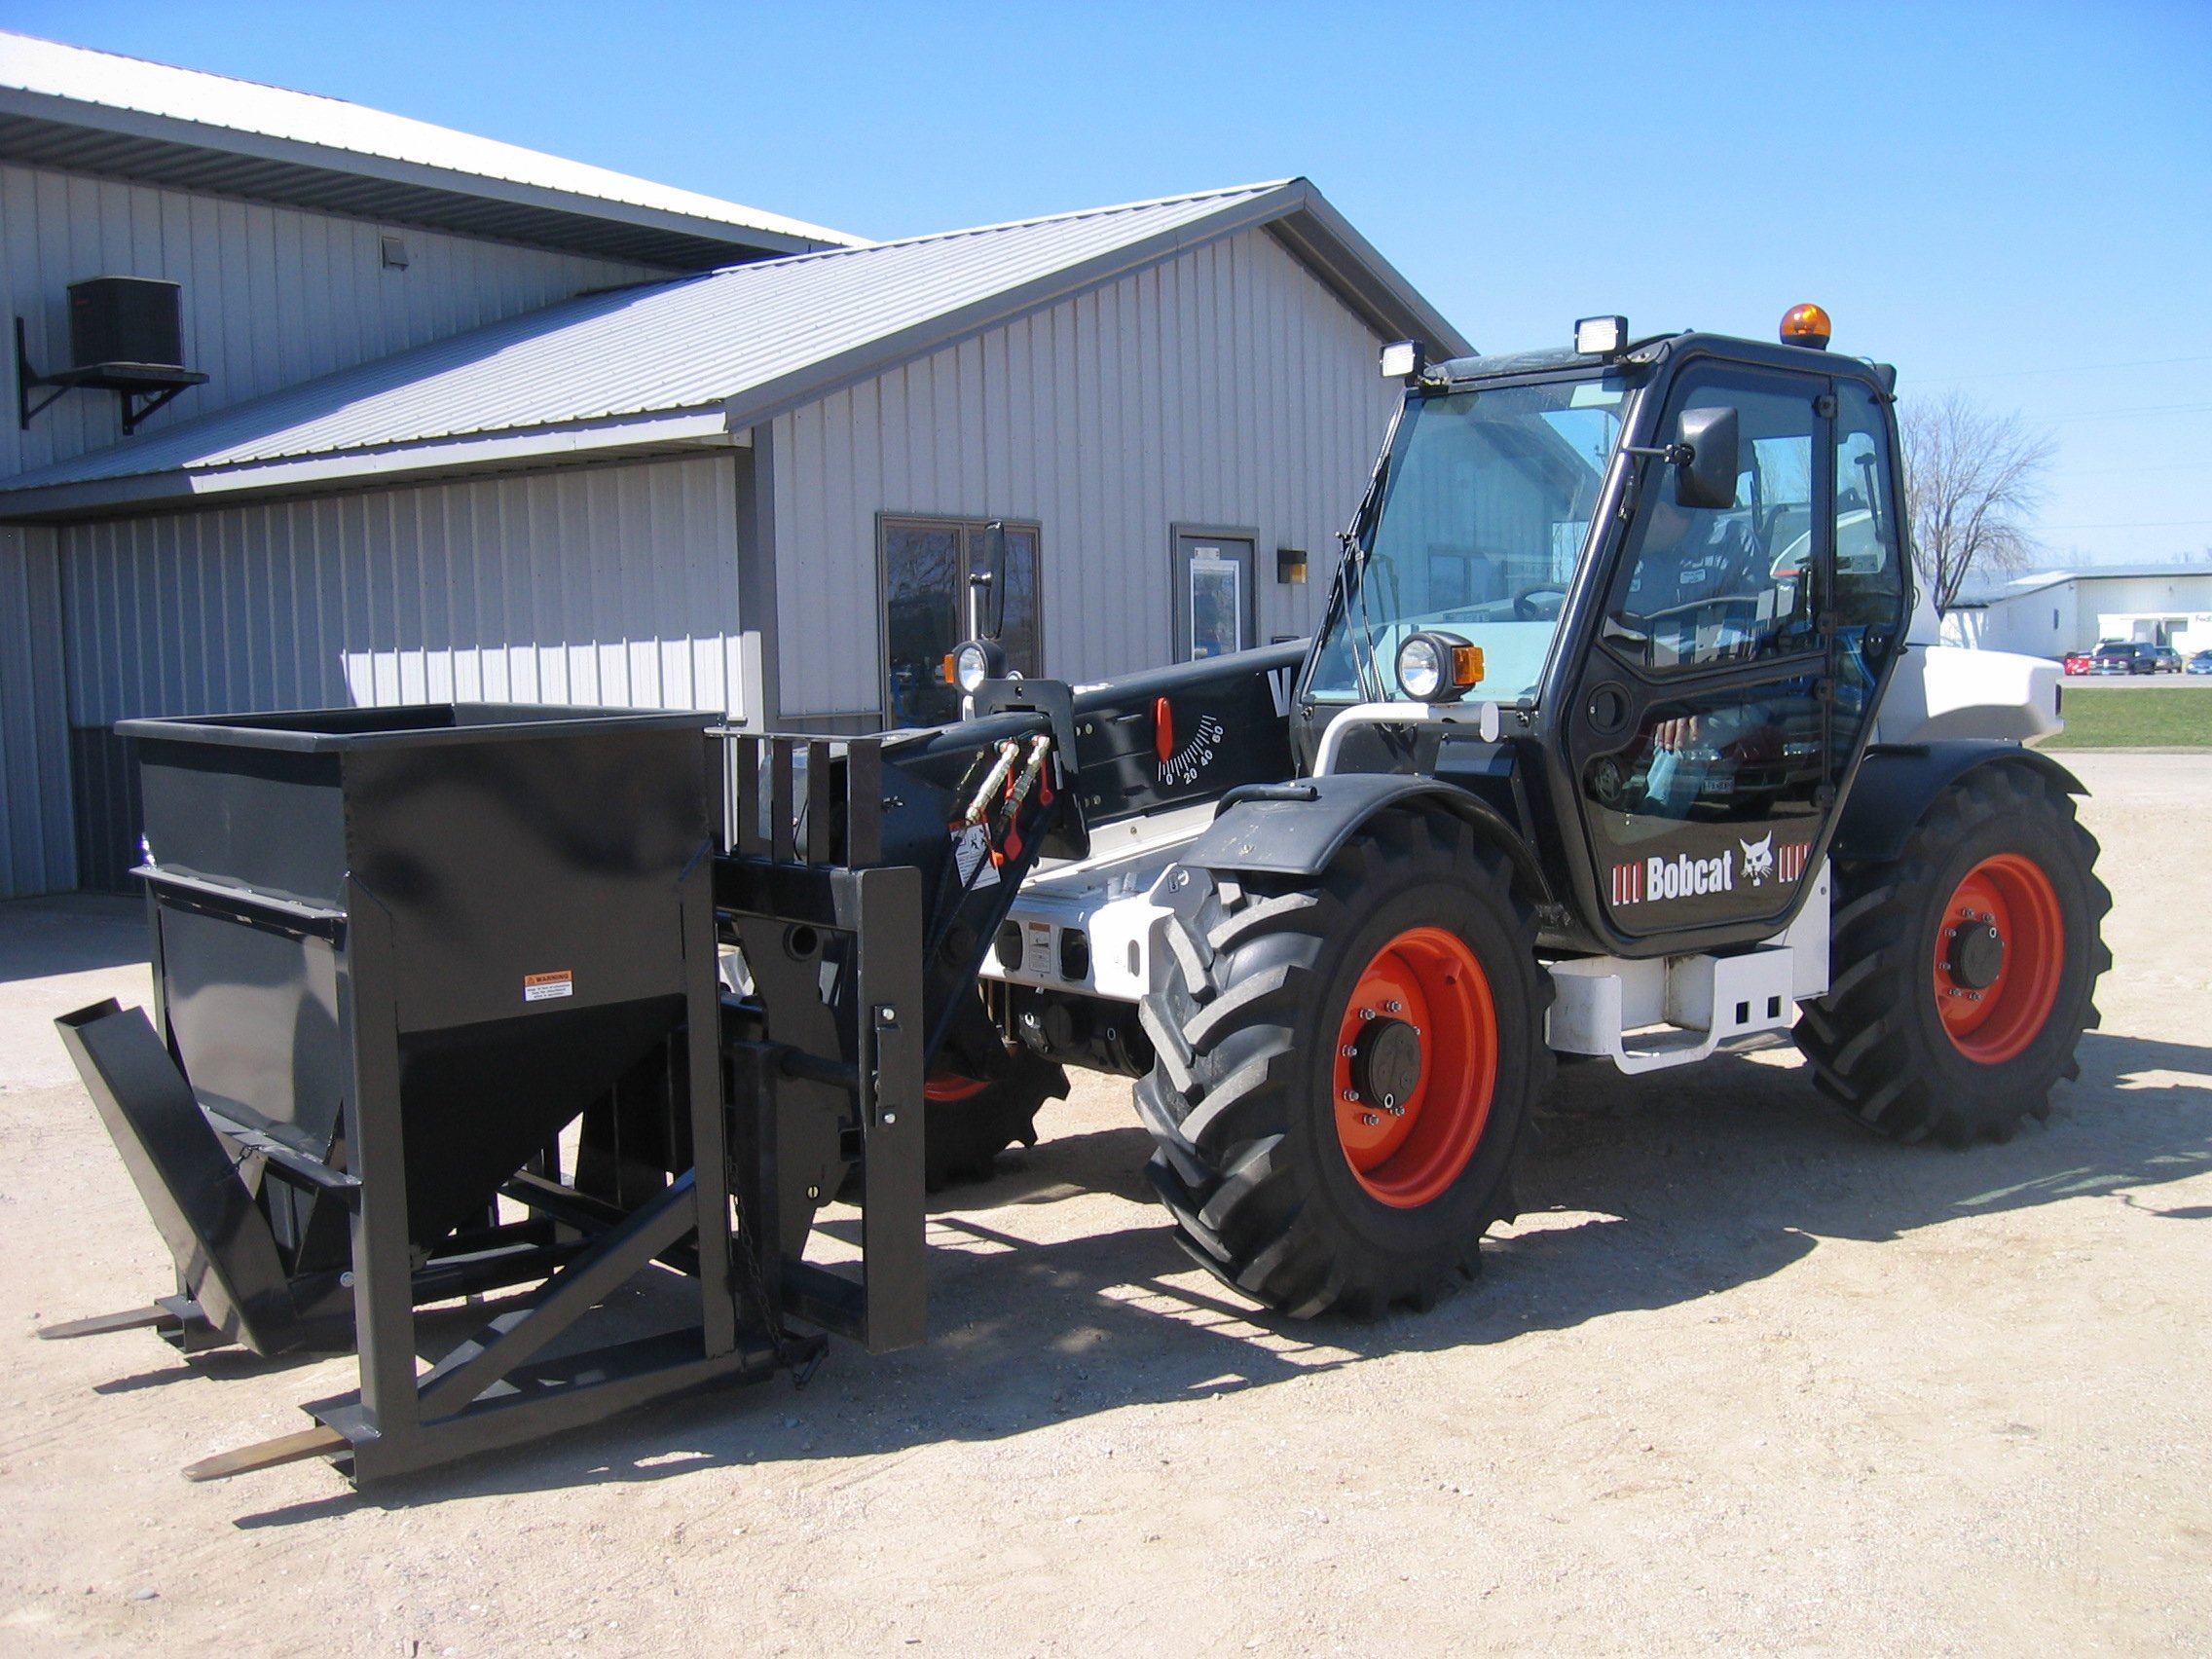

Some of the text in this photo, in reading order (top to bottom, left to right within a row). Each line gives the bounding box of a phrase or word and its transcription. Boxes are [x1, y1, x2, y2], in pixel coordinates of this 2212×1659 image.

[1165, 725, 1224, 786] 0 20 40 60
[1646, 850, 1732, 902] Bobcat
[536, 974, 569, 982] WARNING
